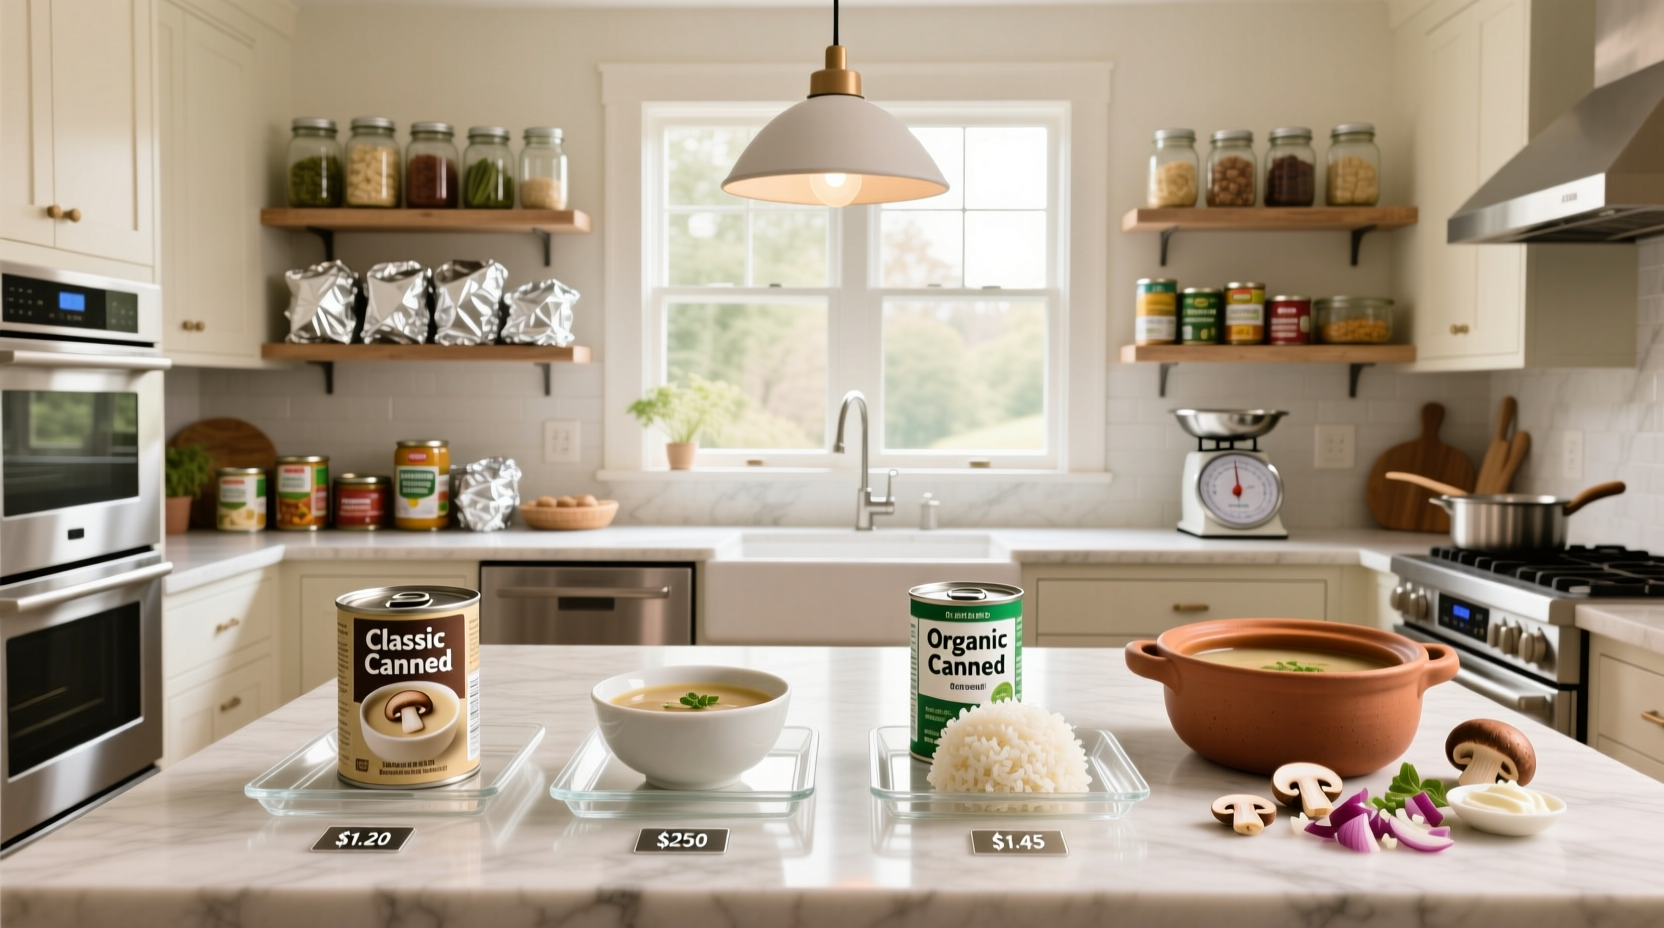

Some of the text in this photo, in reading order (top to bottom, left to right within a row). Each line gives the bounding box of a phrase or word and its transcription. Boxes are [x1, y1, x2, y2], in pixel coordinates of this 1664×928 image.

[365, 626, 446, 651] Classic
[927, 627, 1008, 657] Organic
[364, 648, 453, 675] Canned
[928, 653, 1005, 676] Canned
[335, 830, 392, 849] $1.20
[657, 830, 708, 850] $250
[992, 831, 1045, 851] $1.45
